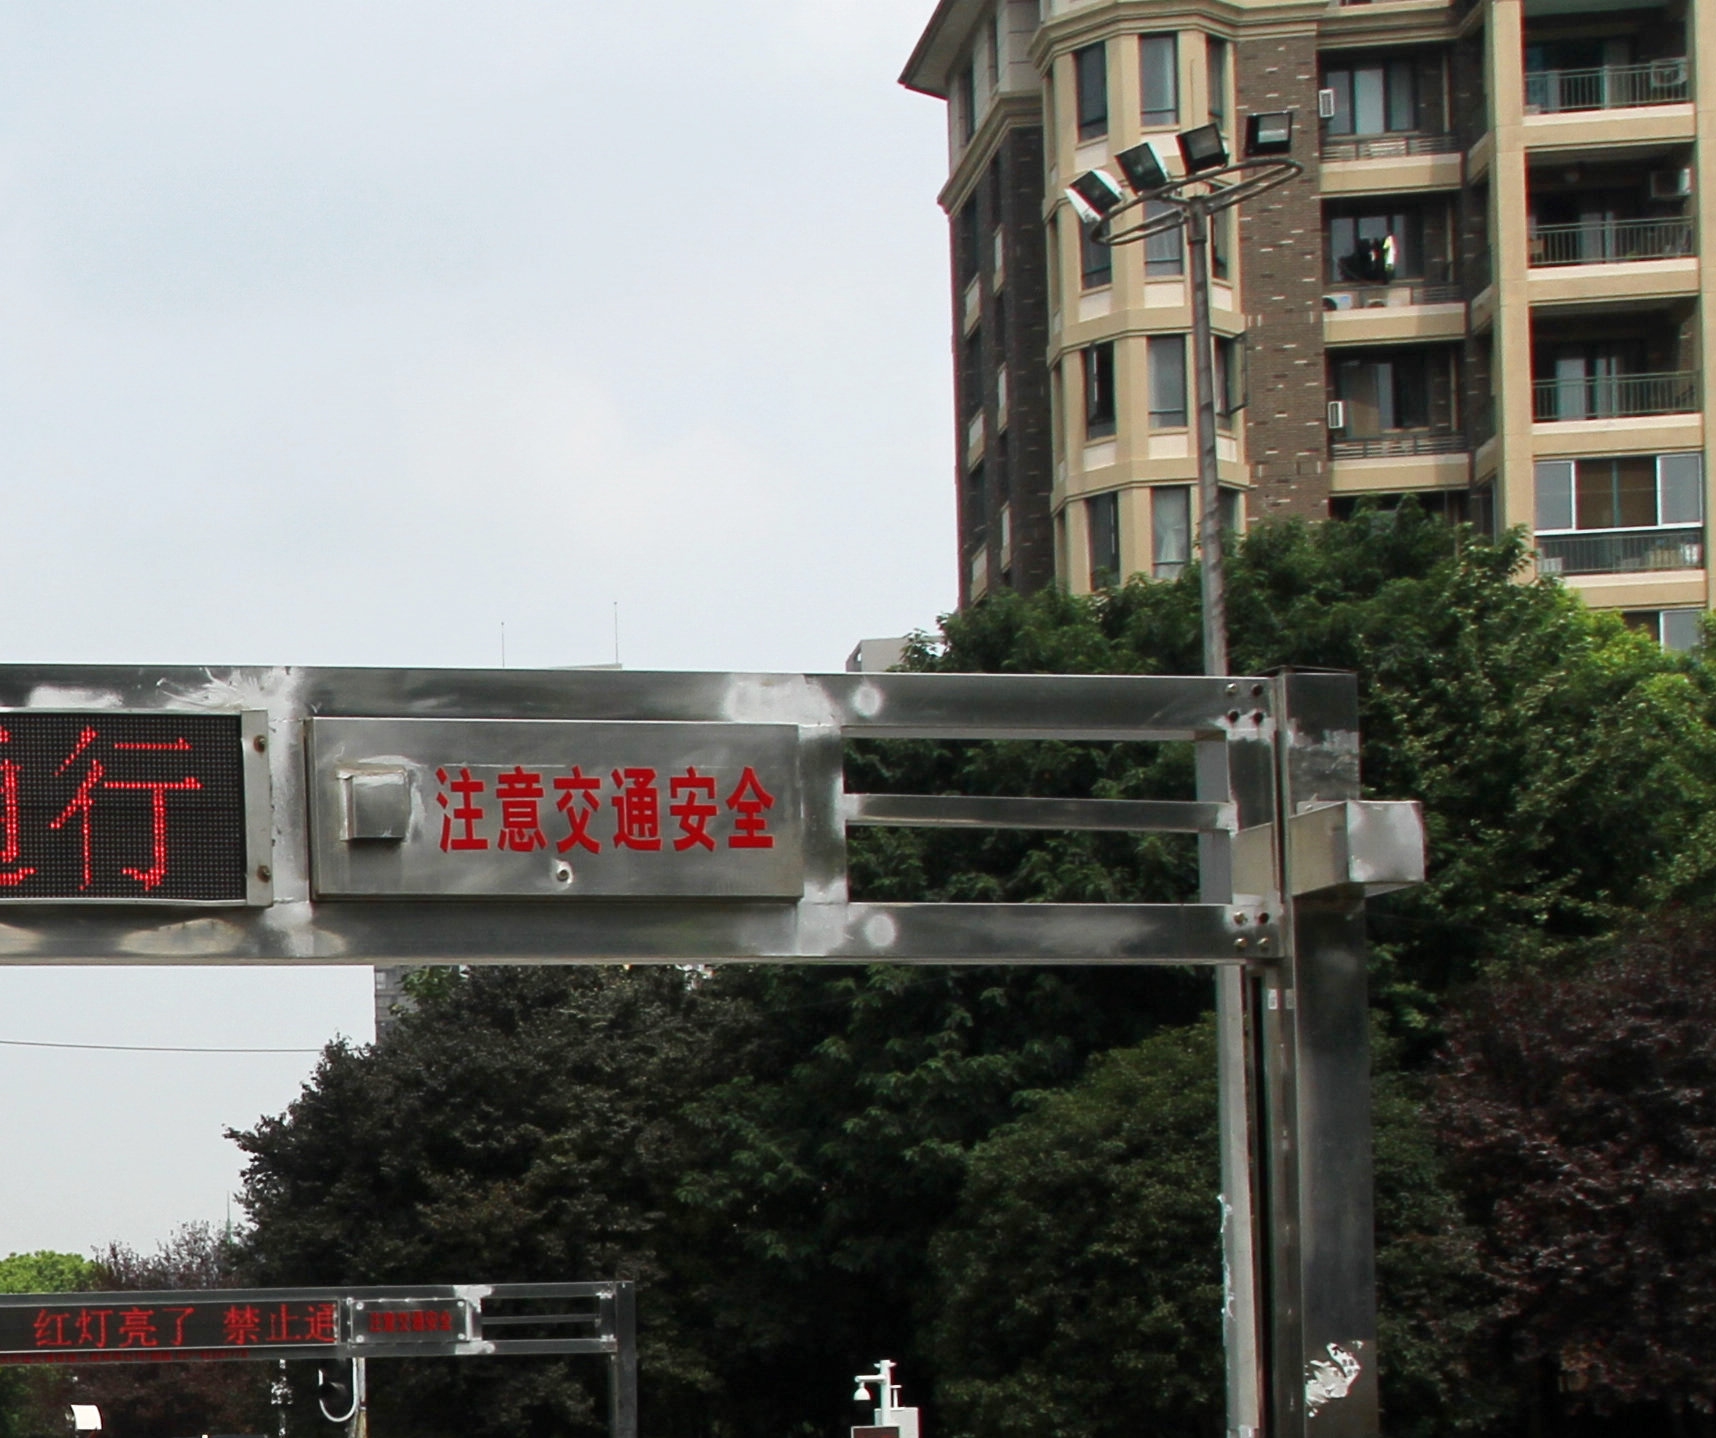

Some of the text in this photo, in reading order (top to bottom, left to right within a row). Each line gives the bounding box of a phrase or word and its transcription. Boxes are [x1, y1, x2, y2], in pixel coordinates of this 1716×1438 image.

[434, 764, 775, 855] 注意交通安全
[34, 1307, 195, 1348] 红灯亮了
